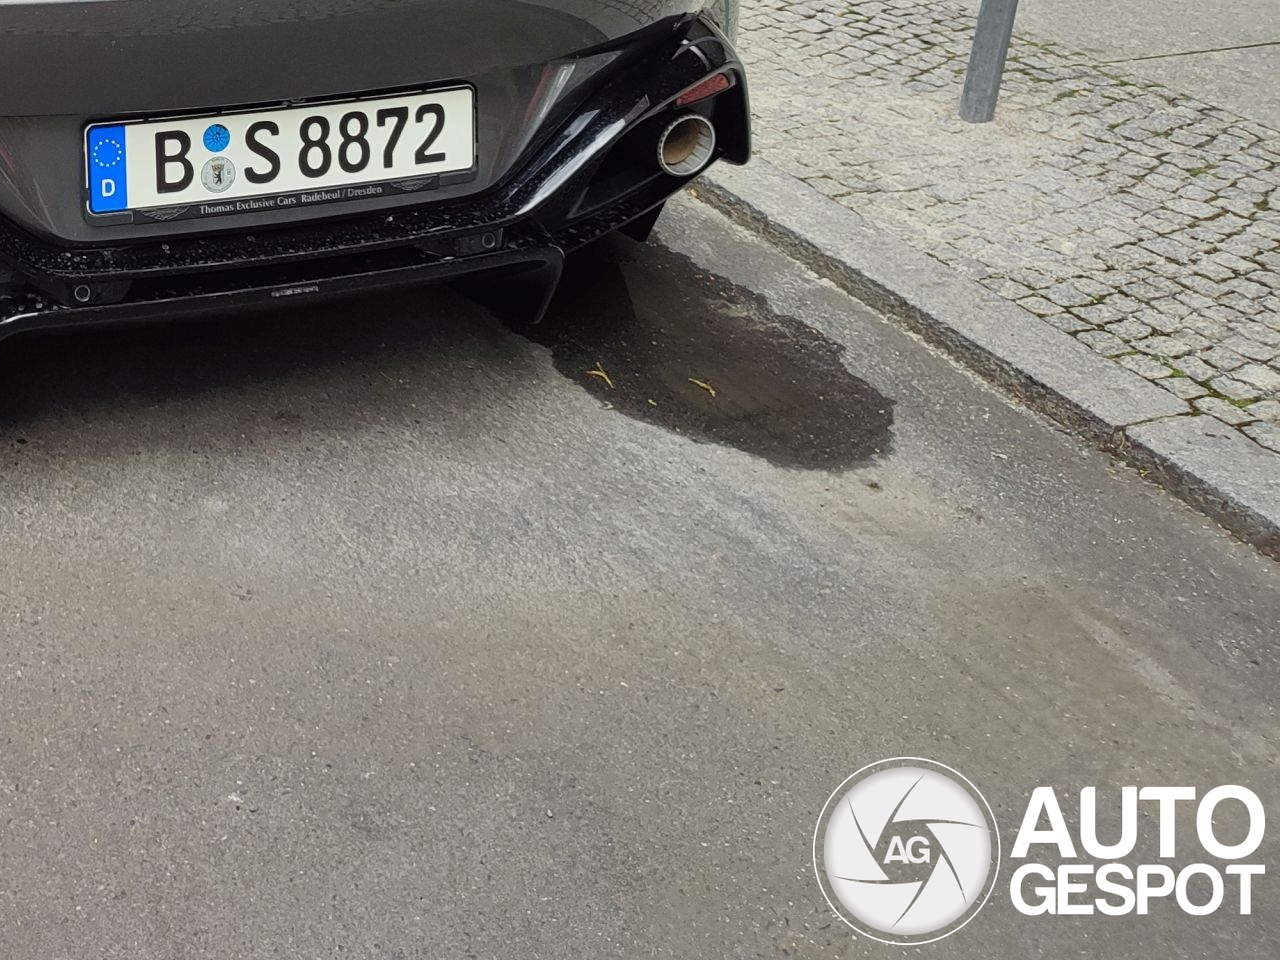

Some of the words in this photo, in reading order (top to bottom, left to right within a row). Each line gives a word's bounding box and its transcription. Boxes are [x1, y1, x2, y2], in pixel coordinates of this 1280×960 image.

[154, 130, 194, 194] B
[244, 121, 281, 184] S
[298, 103, 446, 178] 8872
[101, 178, 116, 197] D
[199, 204, 234, 215] Thomas
[236, 198, 276, 211] Exclusive
[277, 196, 297, 206] Cars
[301, 190, 341, 203] Radebeul
[347, 185, 383, 197] Dresden
